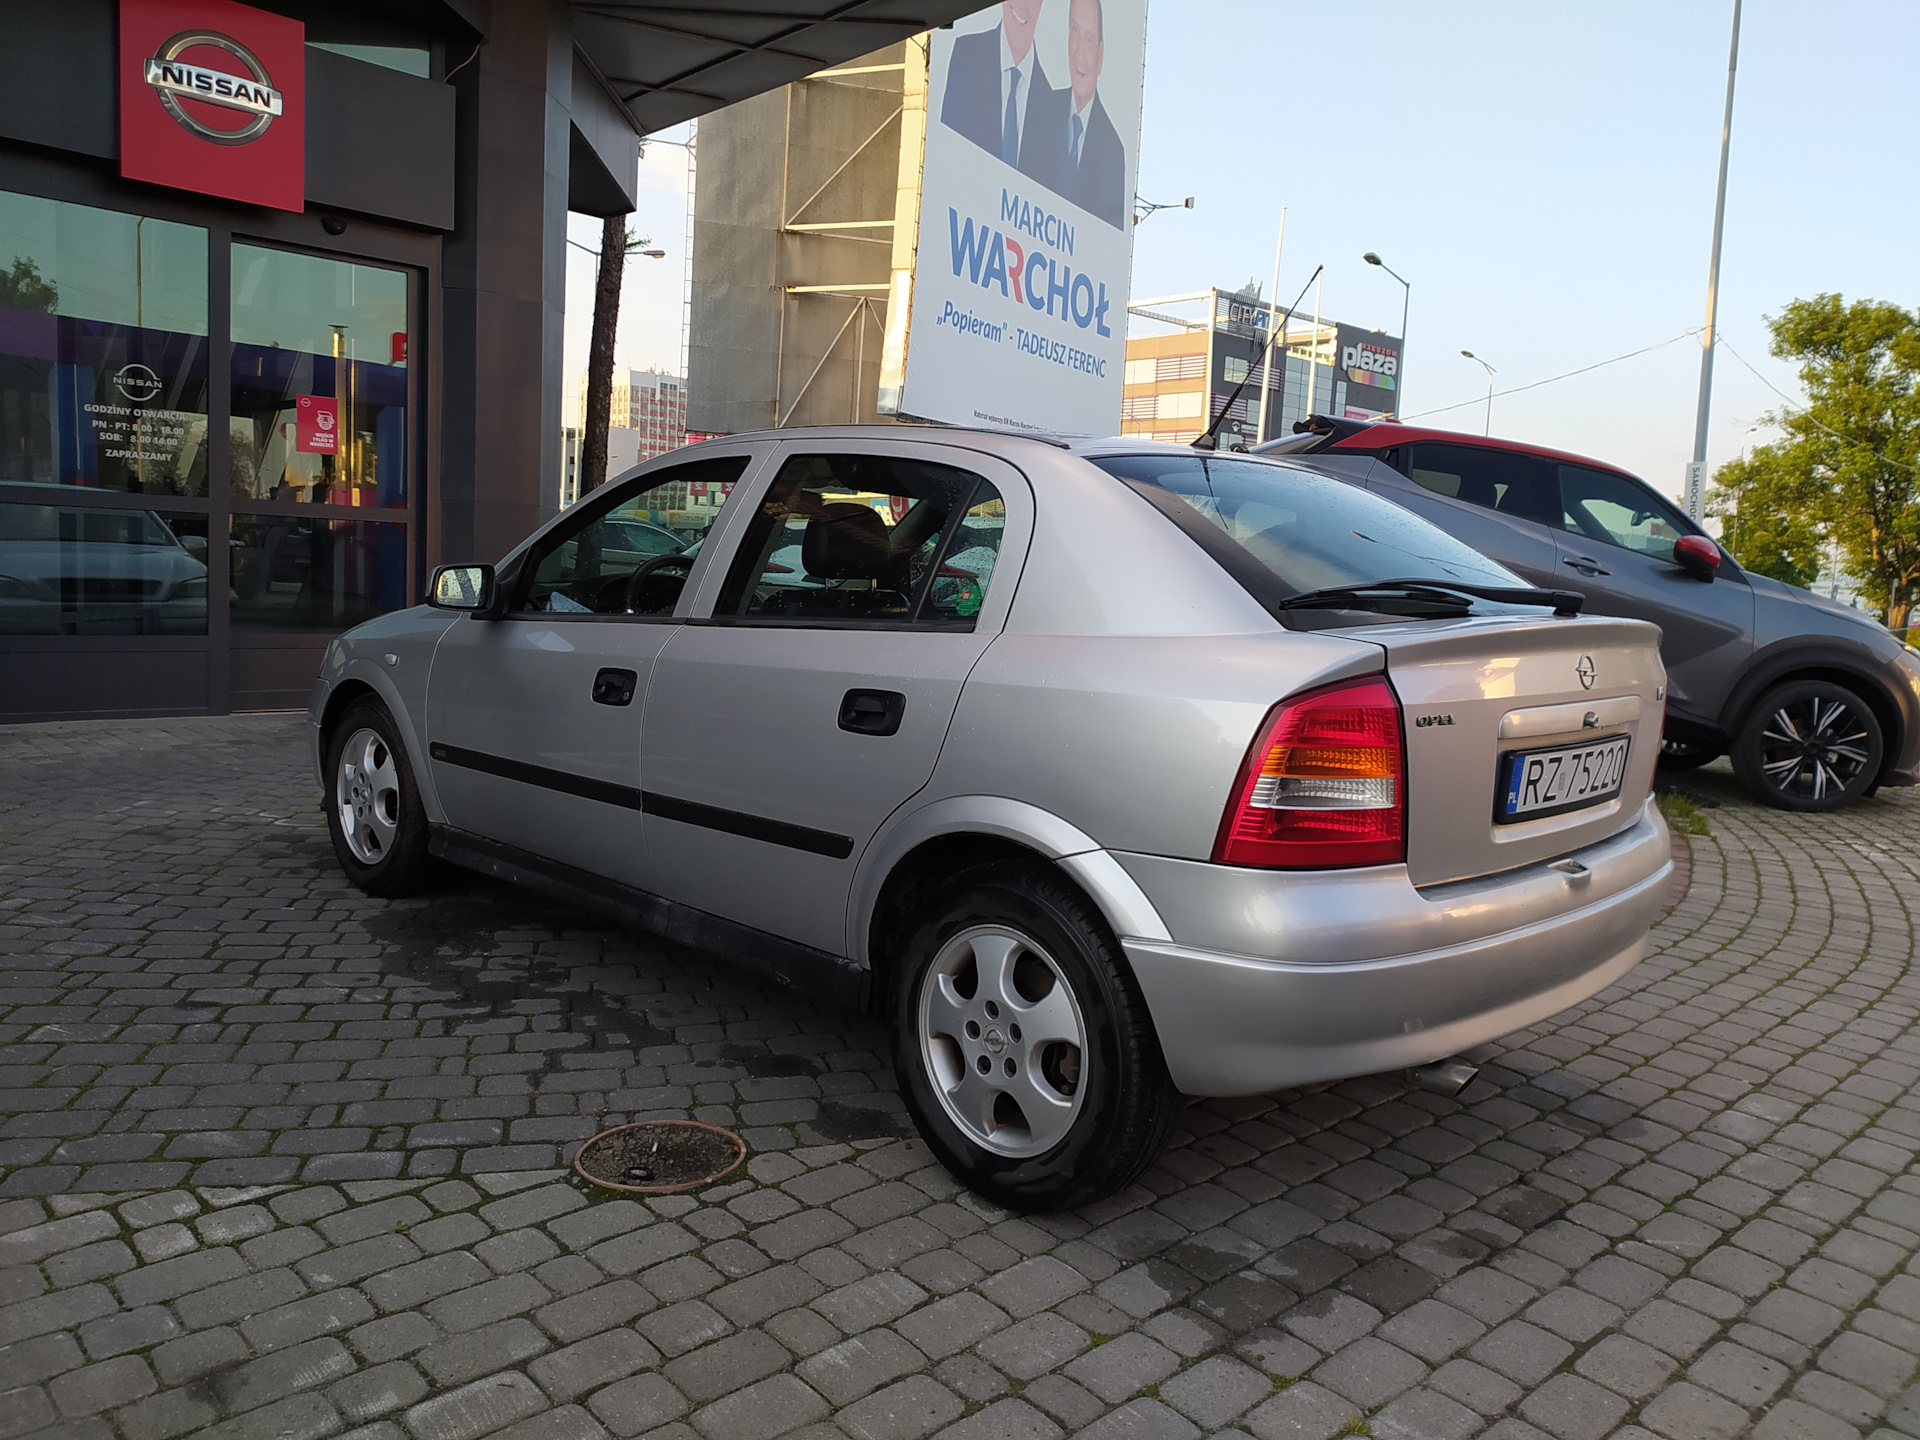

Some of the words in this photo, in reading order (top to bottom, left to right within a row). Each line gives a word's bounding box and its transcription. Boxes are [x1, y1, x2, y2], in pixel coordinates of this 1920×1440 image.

[162, 65, 271, 108] NISSAN
[1001, 188, 1075, 257] MARCIN
[949, 206, 1111, 338] WARCHOŁ
[1016, 328, 1067, 365] TADEUSZ
[1067, 347, 1107, 378] FERENC
[1342, 342, 1397, 376] plaza
[113, 377, 162, 388] NISSAN
[84, 404, 132, 416] GODZINY
[92, 420, 107, 429] PN
[115, 422, 130, 431] PT:
[99, 432, 123, 441] SOB:
[105, 448, 172, 461] ZAPRASZAMY
[1416, 713, 1458, 728] OPEL
[1523, 755, 1563, 806] RZ
[1565, 744, 1624, 799] 75220
[1507, 791, 1517, 804] PL
